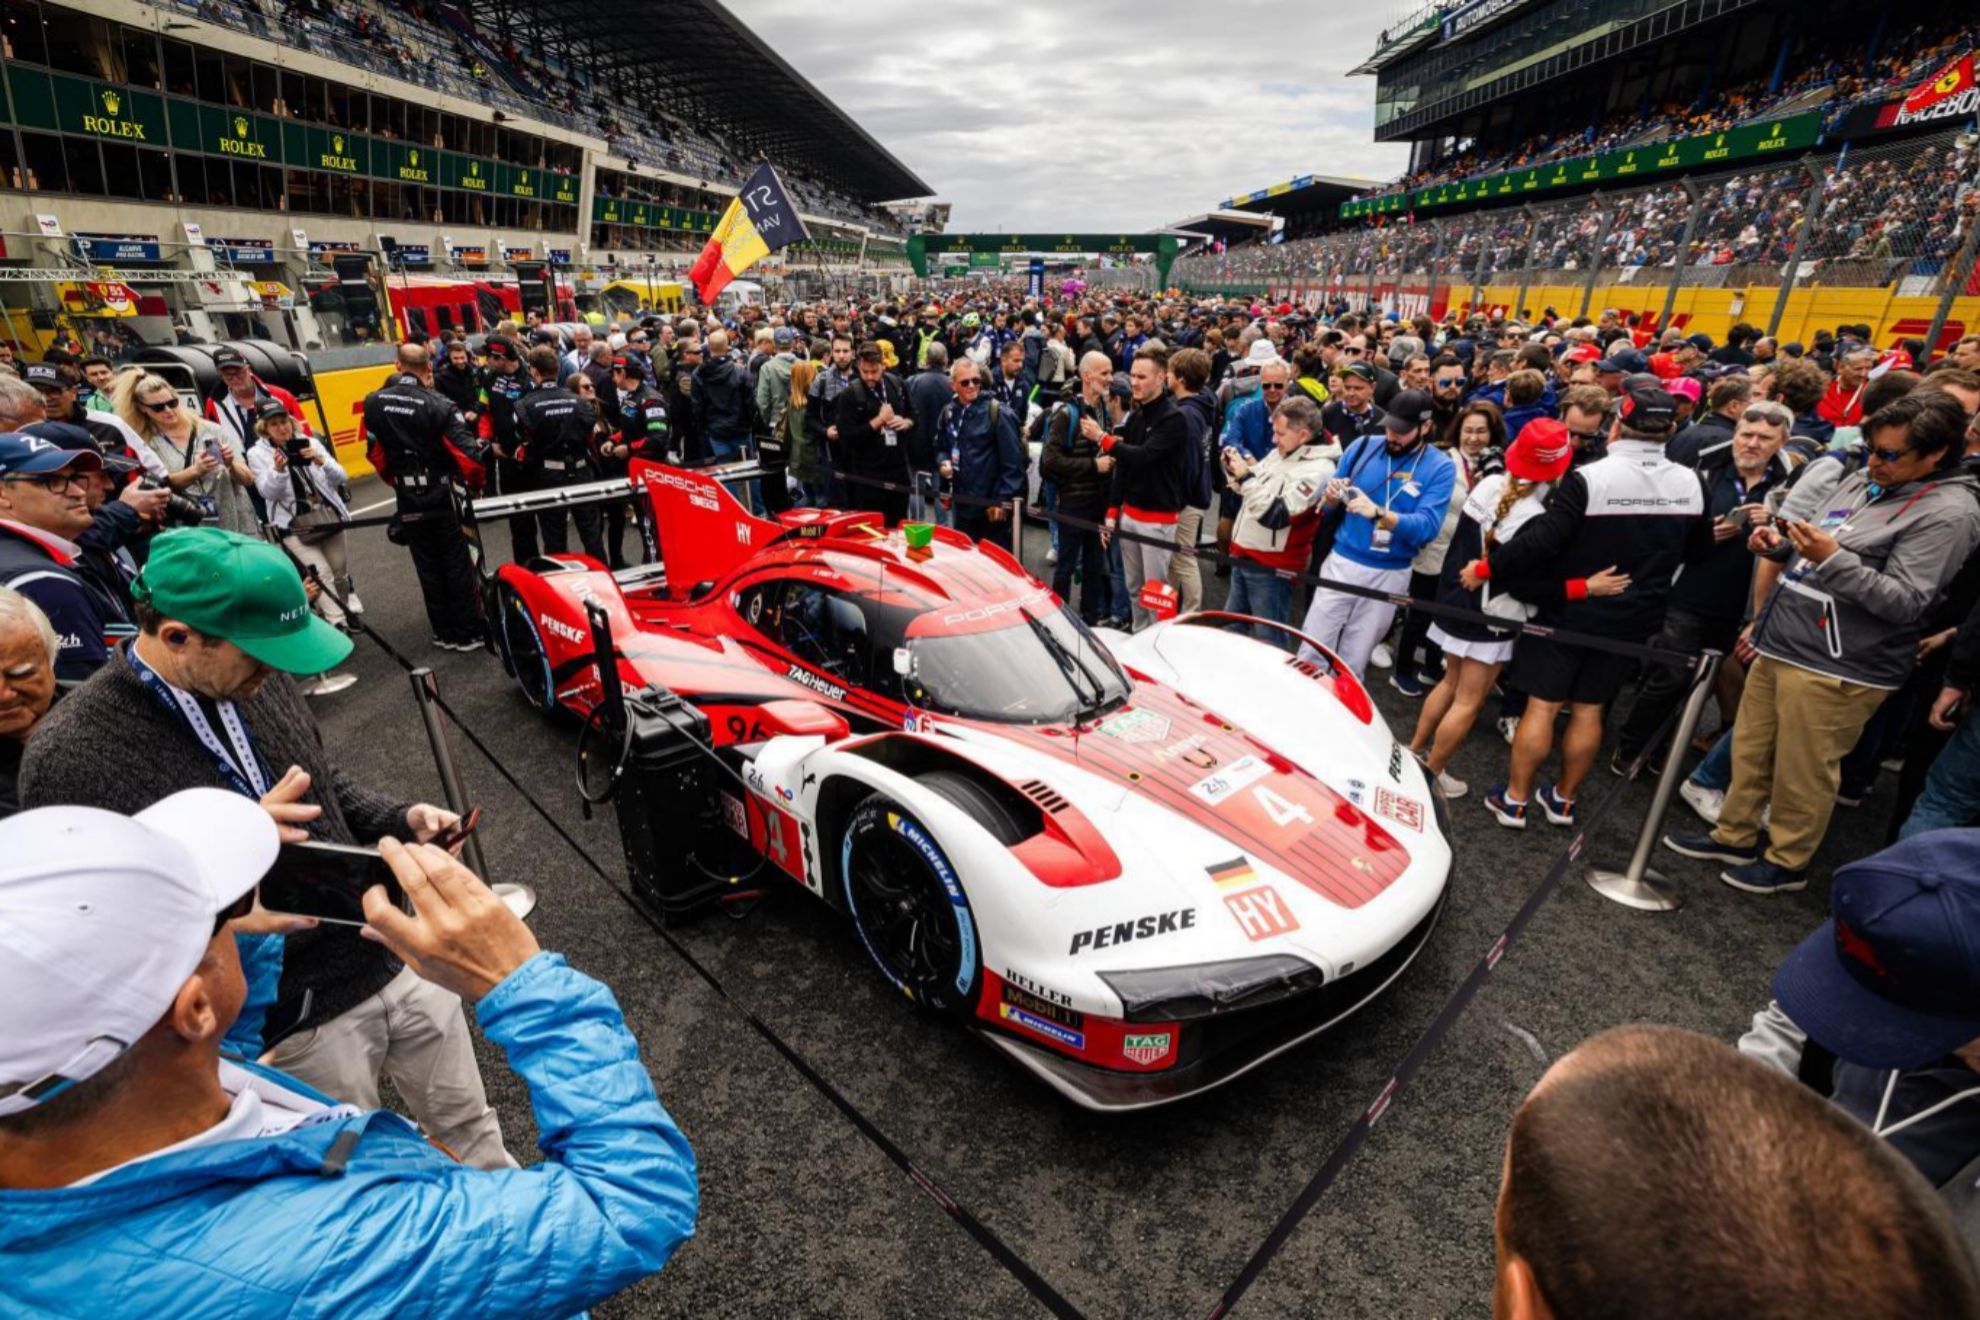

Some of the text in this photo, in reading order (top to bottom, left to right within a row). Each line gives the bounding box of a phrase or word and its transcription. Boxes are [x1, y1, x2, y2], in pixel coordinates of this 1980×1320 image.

[84, 115, 145, 140] ROLEX
[220, 138, 265, 158] ROLEX
[1704, 147, 1729, 159] ROLEX
[1758, 137, 1786, 149] ROLEX
[321, 154, 357, 171] ROLEX
[400, 167, 428, 182] ROLEX
[463, 176, 486, 190] ROLEX
[384, 405, 416, 415] PENSKE
[644, 468, 718, 500] PORSCHE
[690, 494, 720, 512] 963
[1607, 498, 1690, 506] PORSCHE
[736, 521, 751, 545] HY
[540, 613, 586, 645] PENSKE
[1252, 784, 1315, 828] 4
[1395, 797, 1418, 827] CAR
[768, 810, 787, 863] 4
[906, 828, 960, 898] MICHELIN
[1231, 889, 1289, 937] HY
[1069, 908, 1196, 956] PENSKE
[1006, 968, 1073, 1007] HELLER
[1007, 988, 1057, 1018] Mobil
[1023, 1016, 1077, 1042] MICHELIN
[1126, 1035, 1169, 1047] TAG
[1126, 1047, 1169, 1064] HEUER
